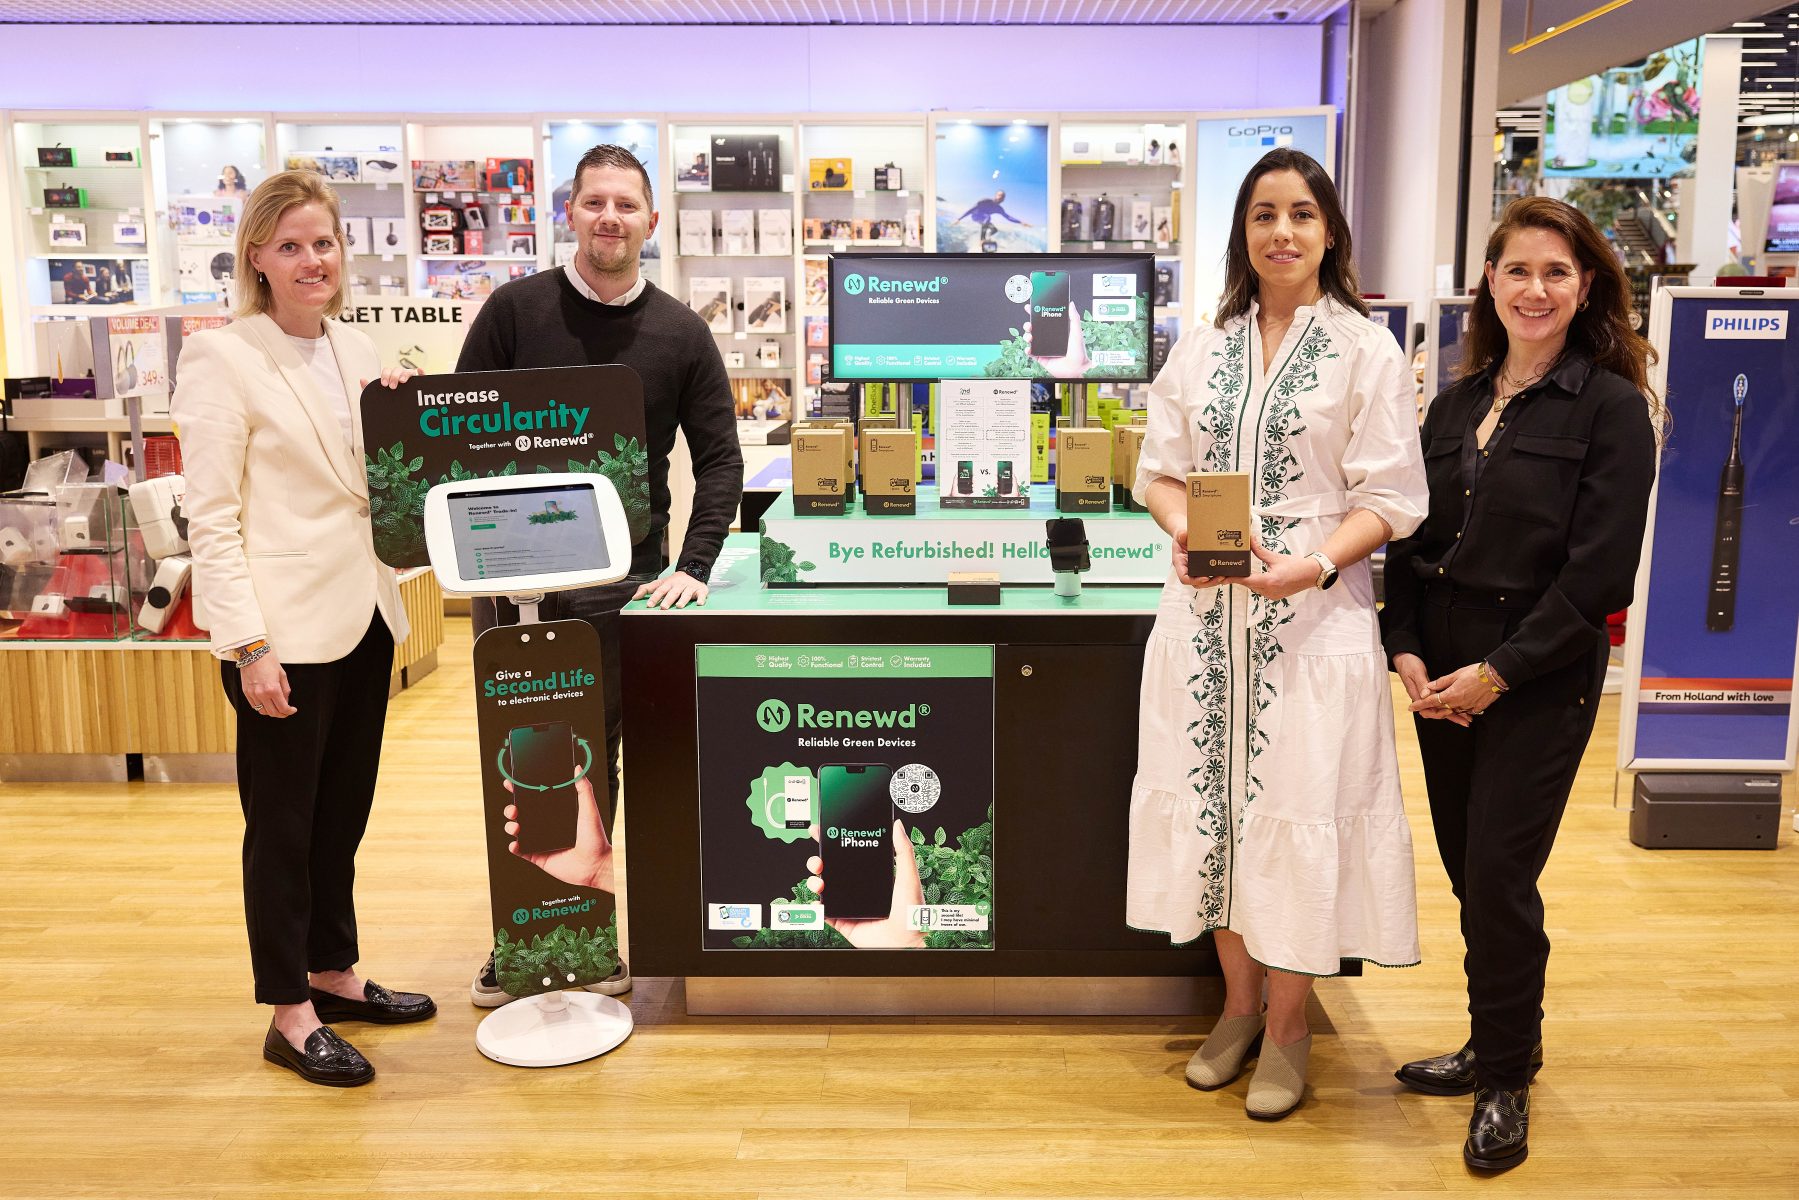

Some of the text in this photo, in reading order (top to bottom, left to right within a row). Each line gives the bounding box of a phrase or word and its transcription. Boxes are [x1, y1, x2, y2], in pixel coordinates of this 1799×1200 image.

[1228, 125, 1293, 136] GoPro
[391, 306, 462, 323] TABLE
[111, 317, 140, 330] VOLUME
[1712, 317, 1780, 331] PHILIPS
[417, 389, 500, 406] Increase
[419, 400, 590, 438] Circularity
[468, 441, 496, 451] Together
[497, 440, 512, 448] with
[829, 541, 1163, 563] Bye Refurbished! Hello enewd®
[768, 661, 793, 669] Quality
[495, 670, 532, 681] Give a
[484, 668, 595, 697] Second Life
[509, 693, 551, 705] electronic
[552, 690, 584, 700] devices
[1655, 692, 1774, 701] From Holland with love
[798, 736, 916, 747] Reliable Green Devices
[840, 837, 879, 848] iPhone
[541, 895, 581, 907] Together with
